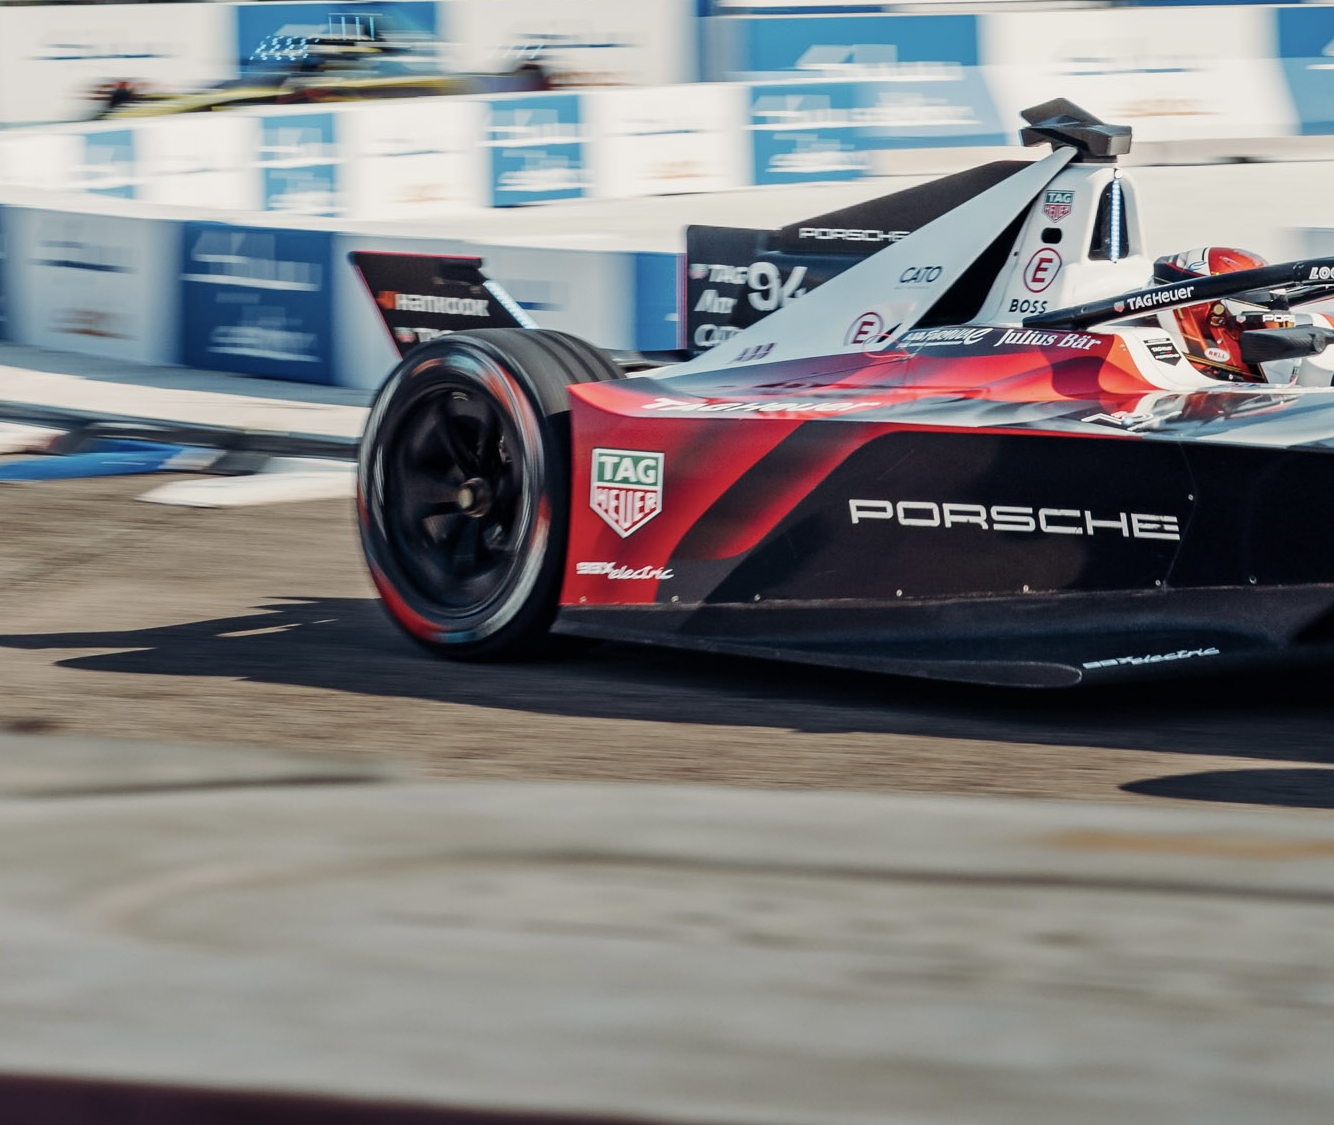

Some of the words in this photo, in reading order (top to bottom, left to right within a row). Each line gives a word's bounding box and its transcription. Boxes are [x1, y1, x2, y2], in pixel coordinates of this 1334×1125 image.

[1048, 192, 1072, 203] TAG
[899, 266, 943, 284] CATO
[1009, 299, 1048, 314] BOSS
[994, 329, 1058, 350] Julius
[1058, 333, 1102, 351] Bär
[1208, 349, 1226, 360] BELL
[598, 455, 657, 484] TAG
[596, 488, 658, 530] HEUER
[849, 499, 1181, 541] PORSCHE
